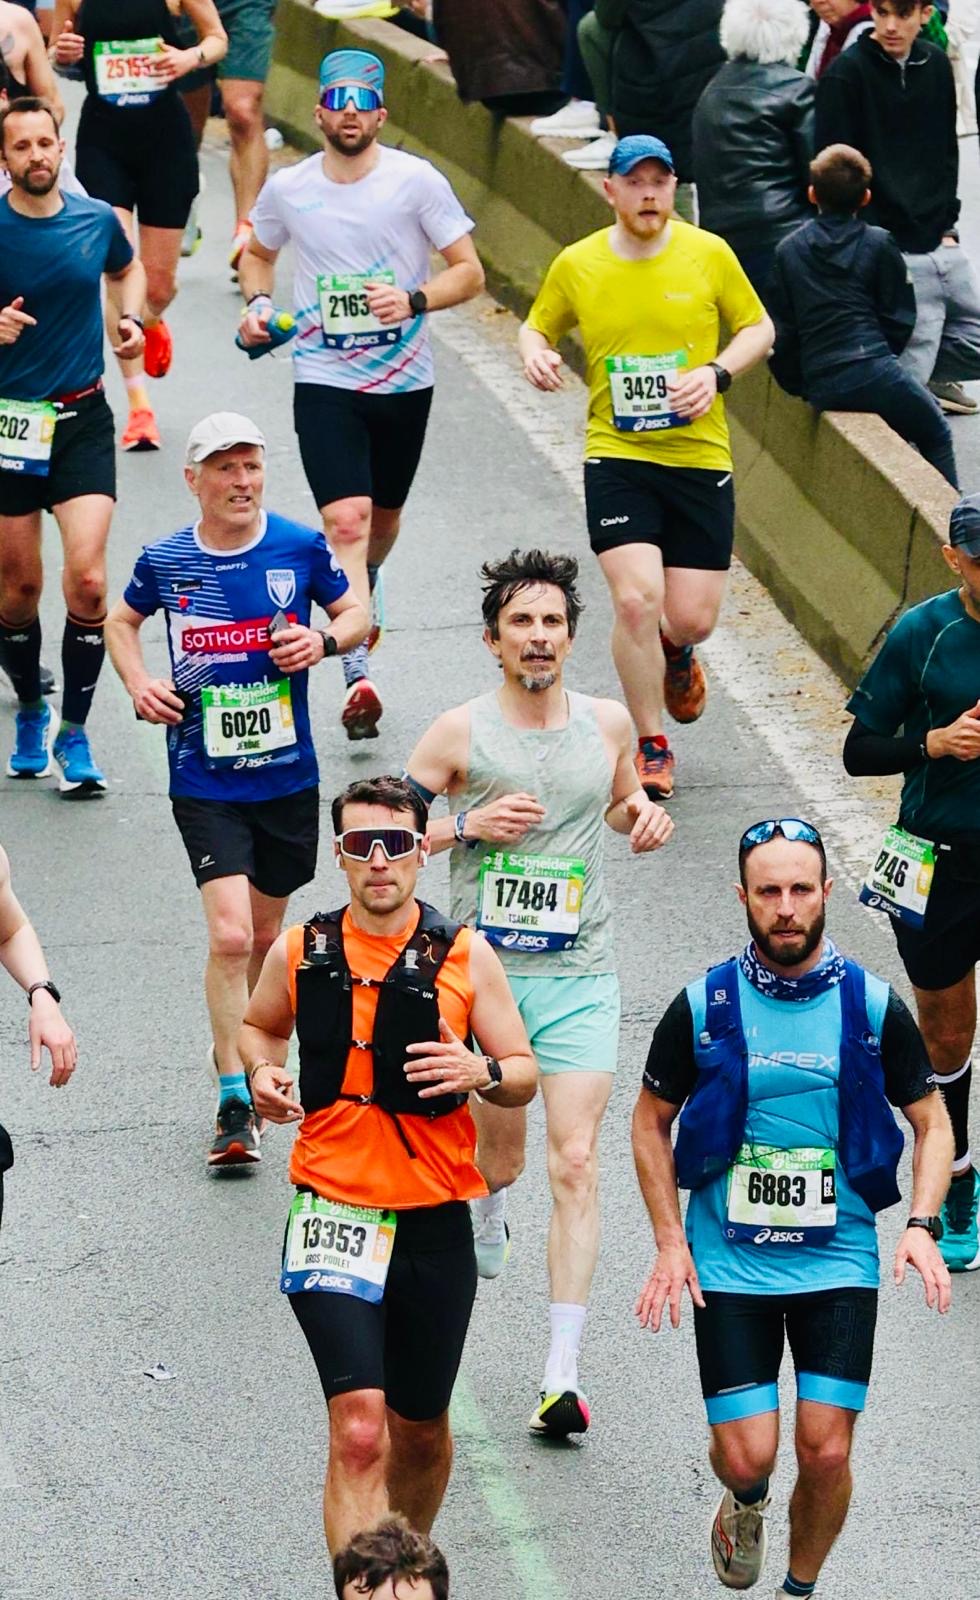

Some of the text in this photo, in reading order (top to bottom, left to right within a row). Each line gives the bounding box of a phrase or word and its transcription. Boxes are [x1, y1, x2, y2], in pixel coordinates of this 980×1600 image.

[623, 374, 668, 401] 3429
[644, 418, 672, 429] asics
[221, 707, 271, 739] 6020
[246, 755, 273, 768] asics
[508, 854, 574, 871] Schneider
[495, 878, 558, 912] 17484
[517, 935, 549, 949] asics
[747, 1171, 806, 1207] 6883
[302, 1217, 367, 1258] 13353
[770, 1231, 805, 1243] asics
[318, 1275, 353, 1290] asics
